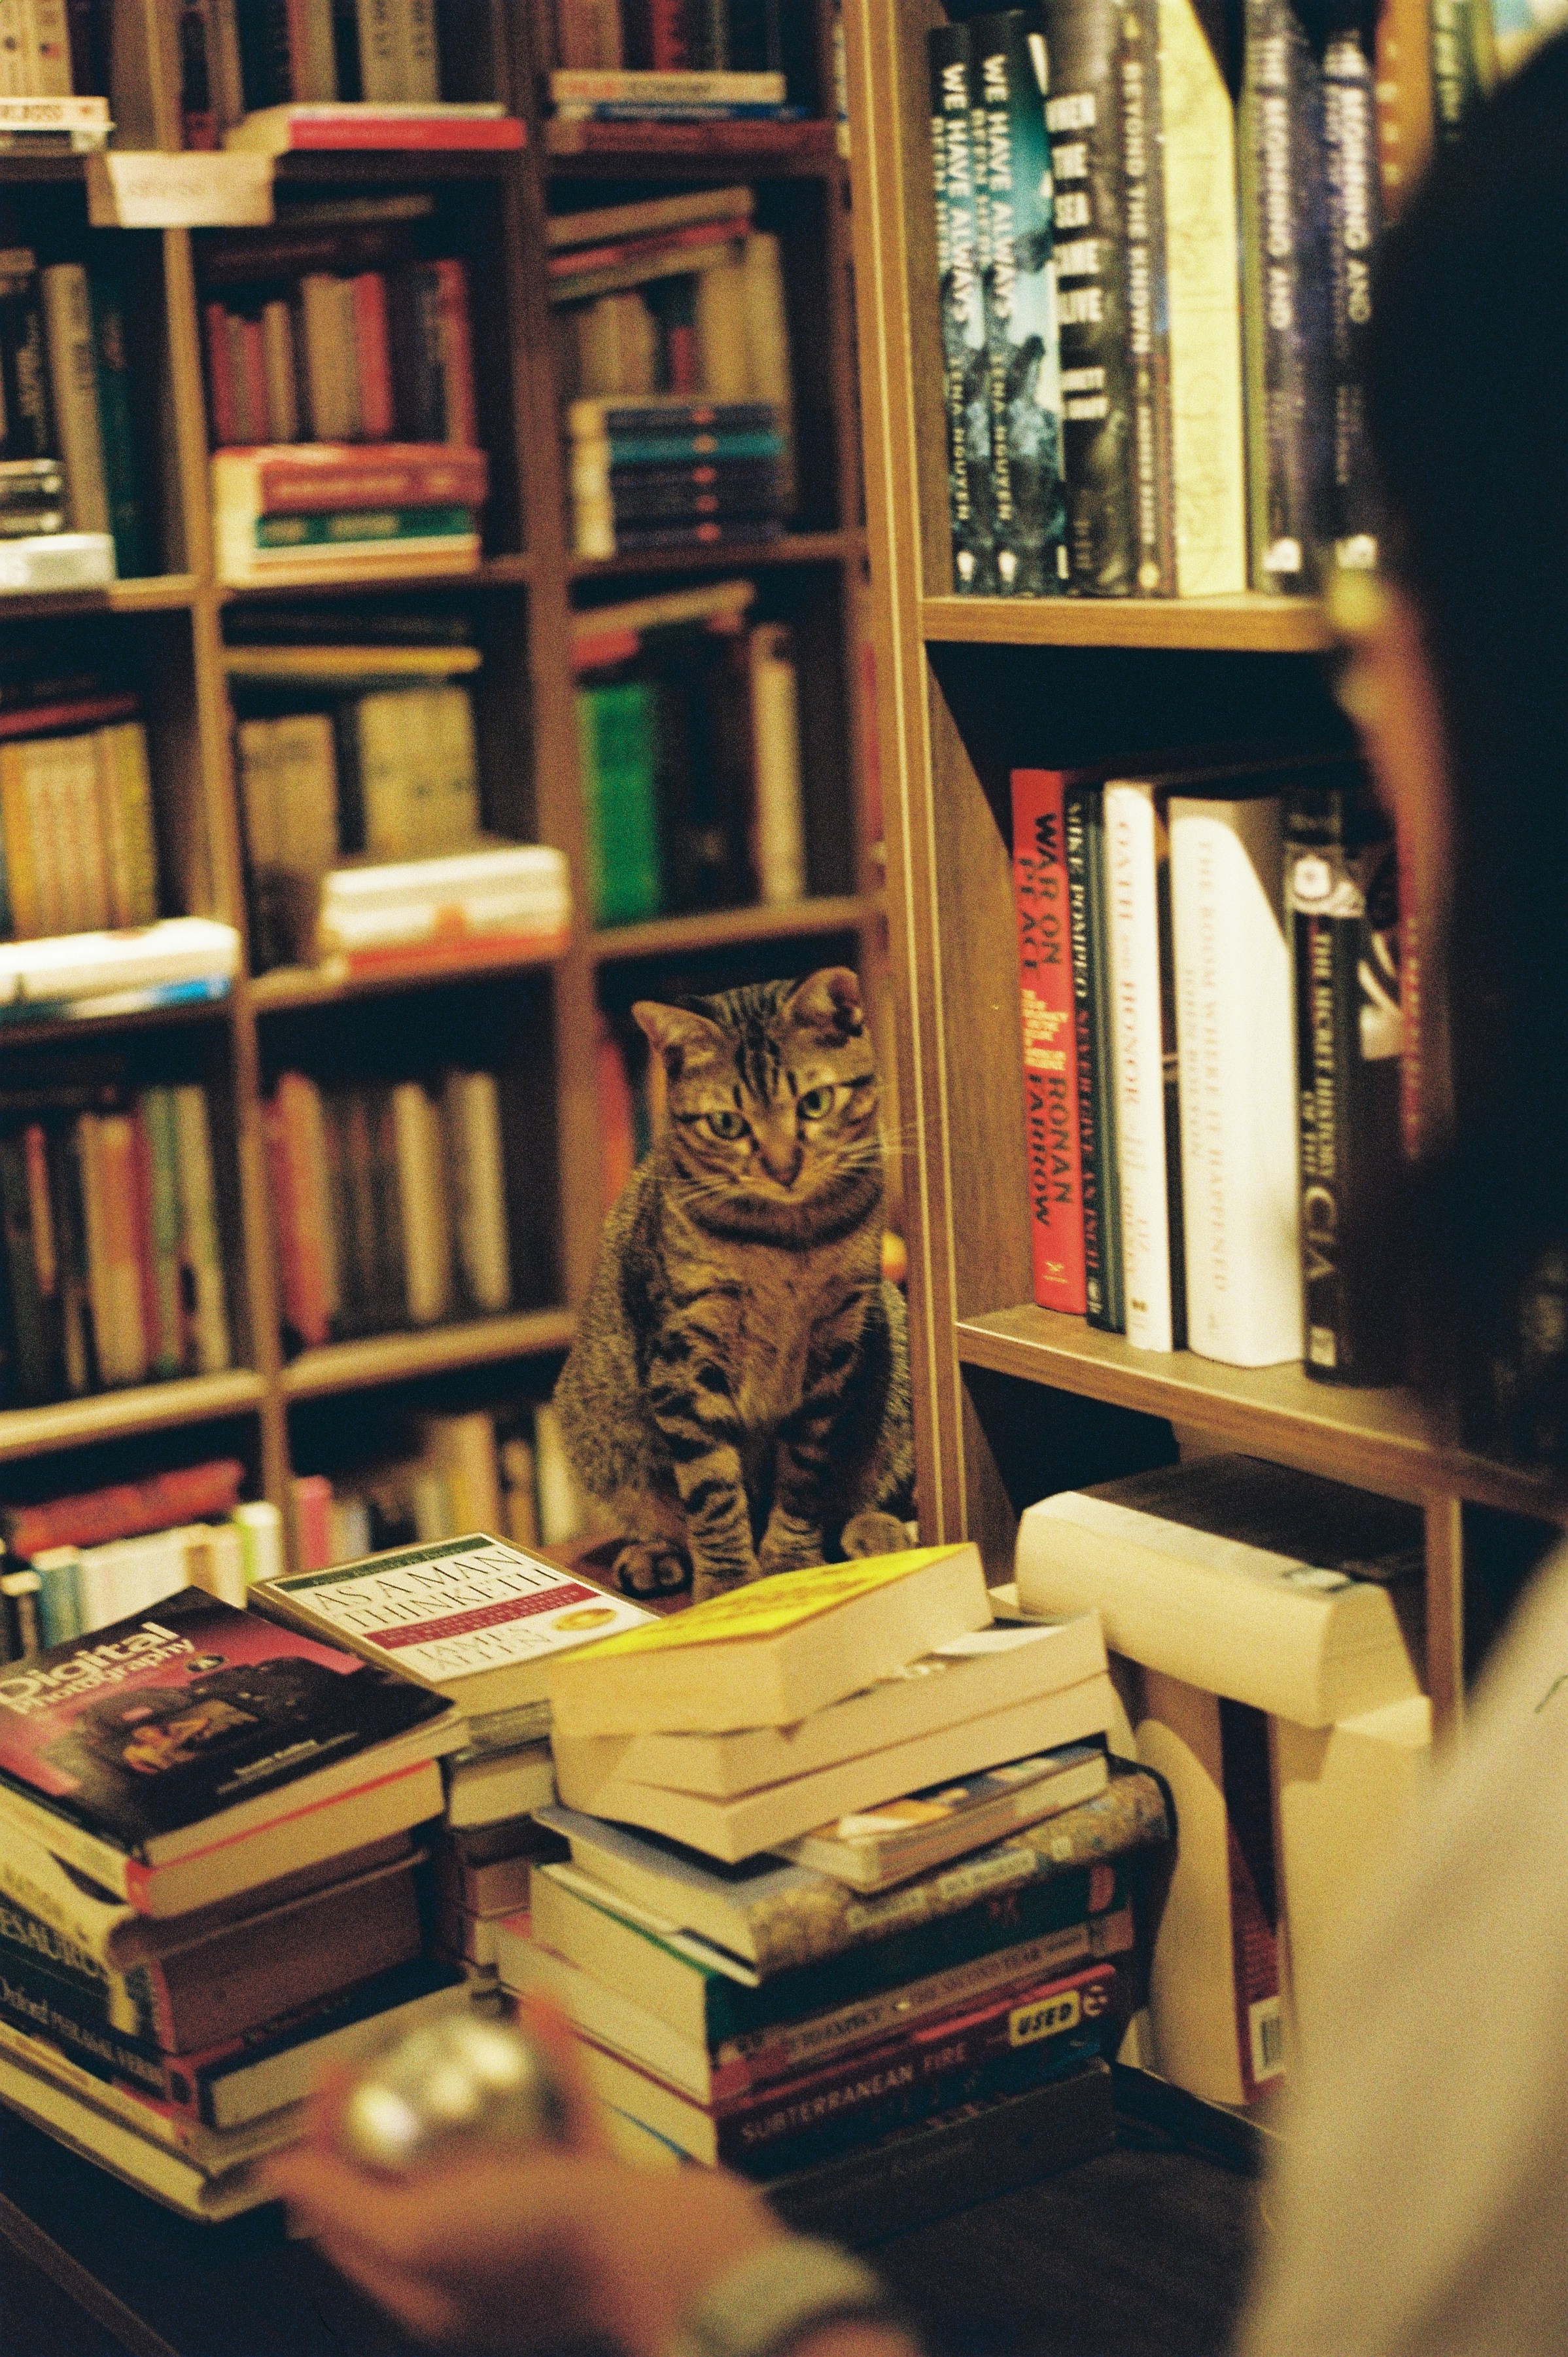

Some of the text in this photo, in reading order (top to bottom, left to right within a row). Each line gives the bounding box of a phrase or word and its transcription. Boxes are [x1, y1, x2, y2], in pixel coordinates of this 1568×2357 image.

[941, 61, 973, 322] WE HAVE ALWAYS
[982, 54, 1018, 319] WE HAVE ALWAYS
[1124, 62, 1153, 355] BEYOND THE KNOWN
[1346, 258, 1374, 324] AND
[1034, 812, 1062, 901] WAR
[1065, 803, 1088, 998] MIKE POMPEO
[1114, 821, 1136, 921] OATH
[1198, 841, 1215, 893] THE
[1017, 857, 1041, 979] PEACE
[1039, 913, 1062, 965] ON
[1200, 906, 1217, 989] ROOM
[1120, 978, 1141, 1107] HONOR
[1203, 1001, 1221, 1095] WHERE
[1315, 987, 1335, 1071] SECRET
[1026, 1072, 1051, 1228] FARROW
[1047, 1076, 1074, 1205] RONAN
[1317, 1078, 1337, 1177] HISTORY
[1207, 1148, 1228, 1292] HAPPENED
[1303, 1186, 1337, 1279] CIA
[313, 1584, 374, 1612] AS
[375, 1578, 413, 1601] A
[407, 1551, 525, 1589] MAN
[334, 1568, 562, 1628] THINKETH
[0, 1622, 182, 1709] Digital
[1017, 2002, 1075, 2036] USED
[742, 2063, 915, 2144] SUBTERRANEAN
[923, 2043, 968, 2072] FIRE
